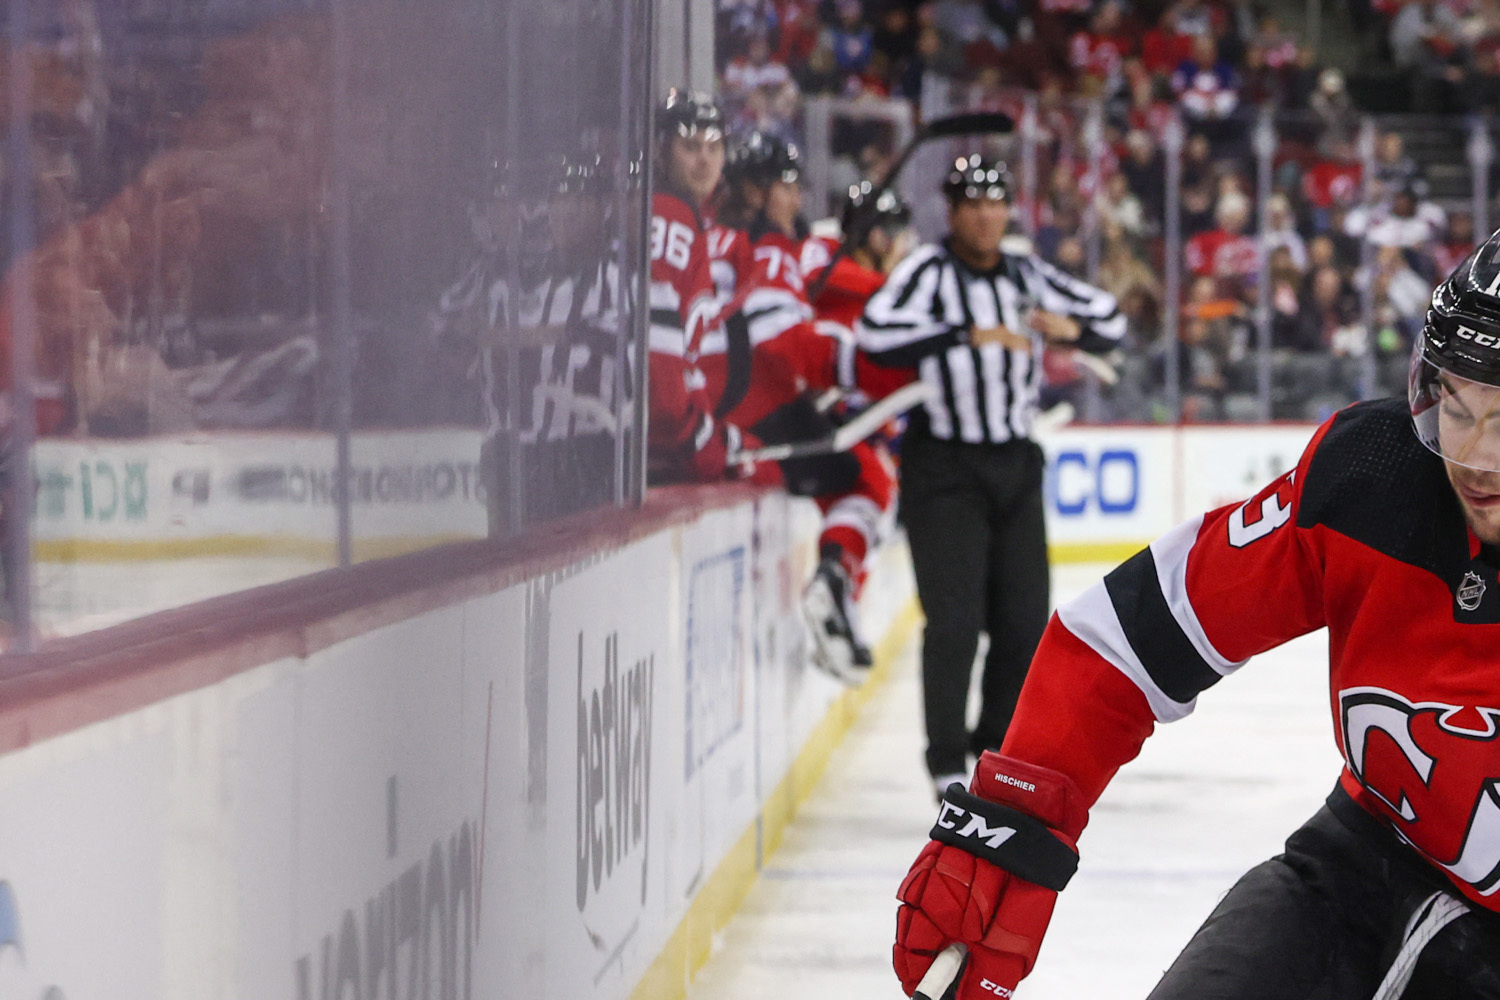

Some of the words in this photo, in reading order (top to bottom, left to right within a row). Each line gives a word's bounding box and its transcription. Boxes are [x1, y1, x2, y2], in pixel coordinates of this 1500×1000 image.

[576, 629, 654, 913] betway
[994, 772, 1036, 793] HISCHIER
[937, 798, 1018, 850] CM
